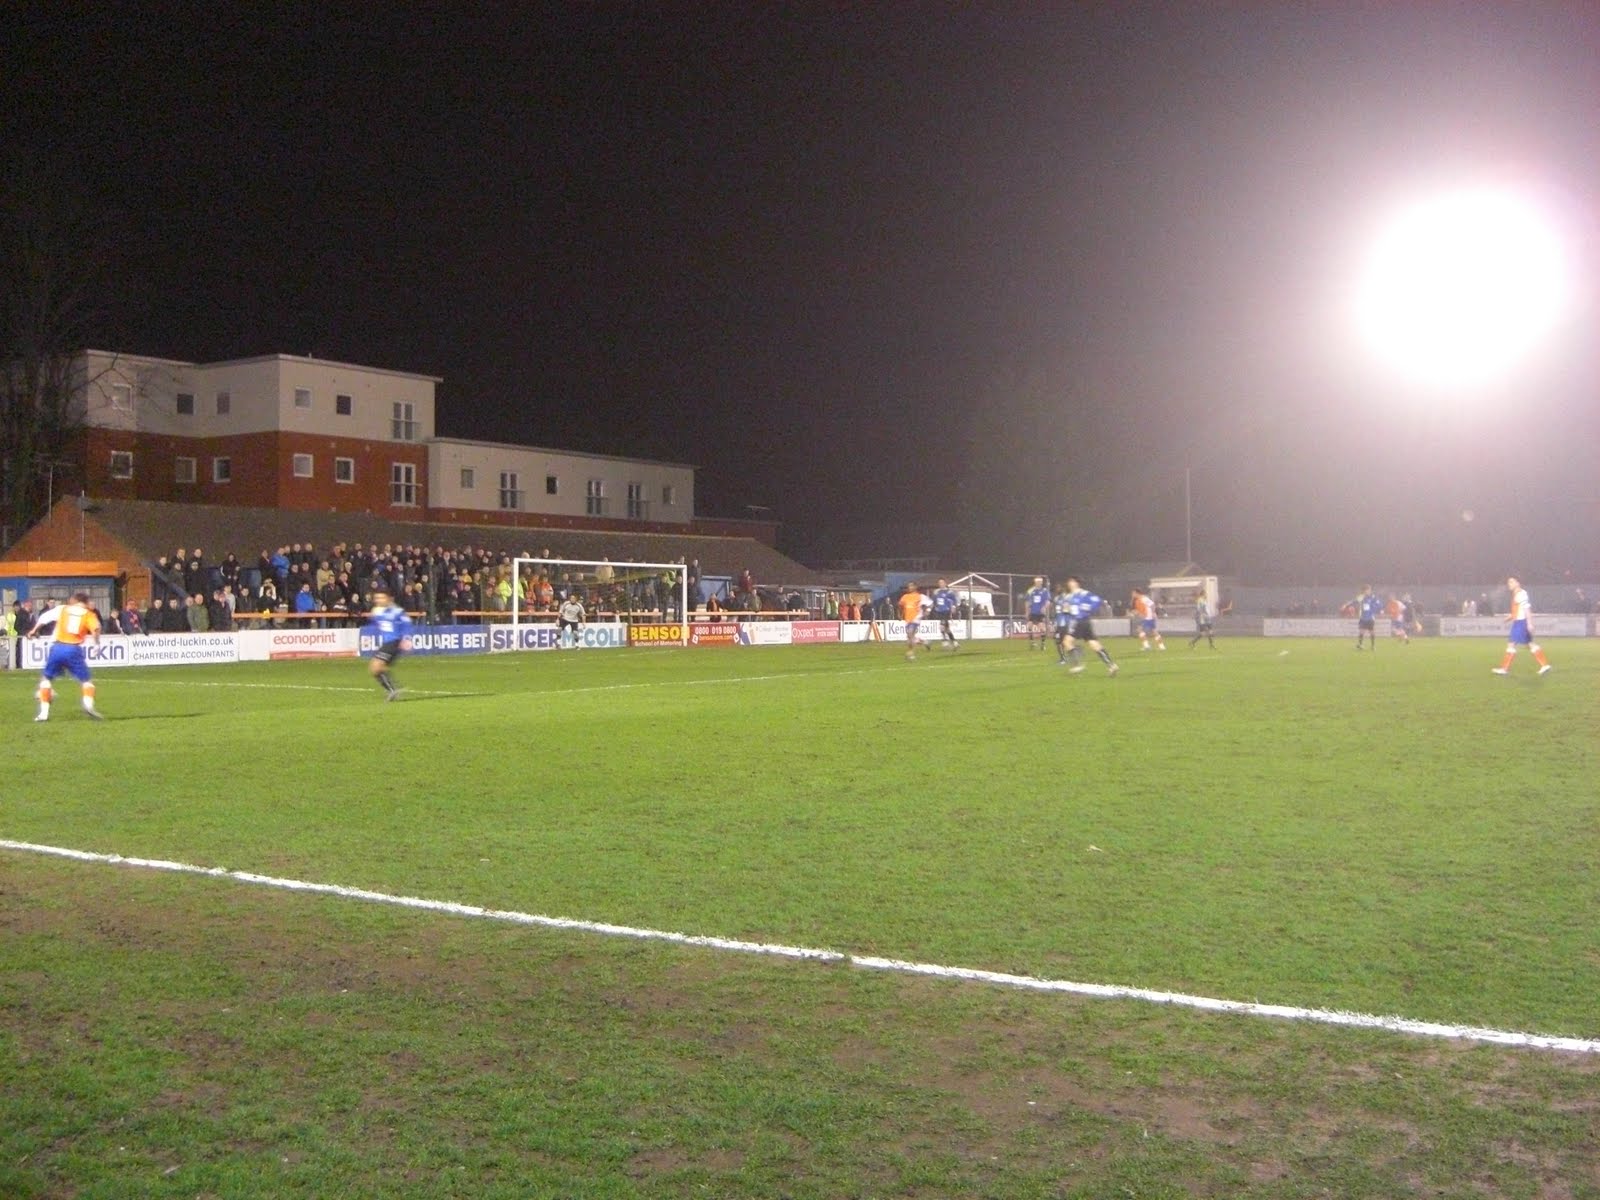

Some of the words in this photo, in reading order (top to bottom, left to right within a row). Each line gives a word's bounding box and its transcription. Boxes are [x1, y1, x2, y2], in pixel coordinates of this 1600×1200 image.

[888, 622, 906, 635] Ken
[914, 622, 938, 634] laxill
[132, 636, 234, 647] www.bird-luckin.co.uk
[273, 632, 336, 646] econoprint
[403, 633, 459, 650] QUARE
[462, 633, 488, 648] BET
[133, 652, 179, 660] CHARTERED
[180, 650, 235, 660] ACCOUNTANTS
